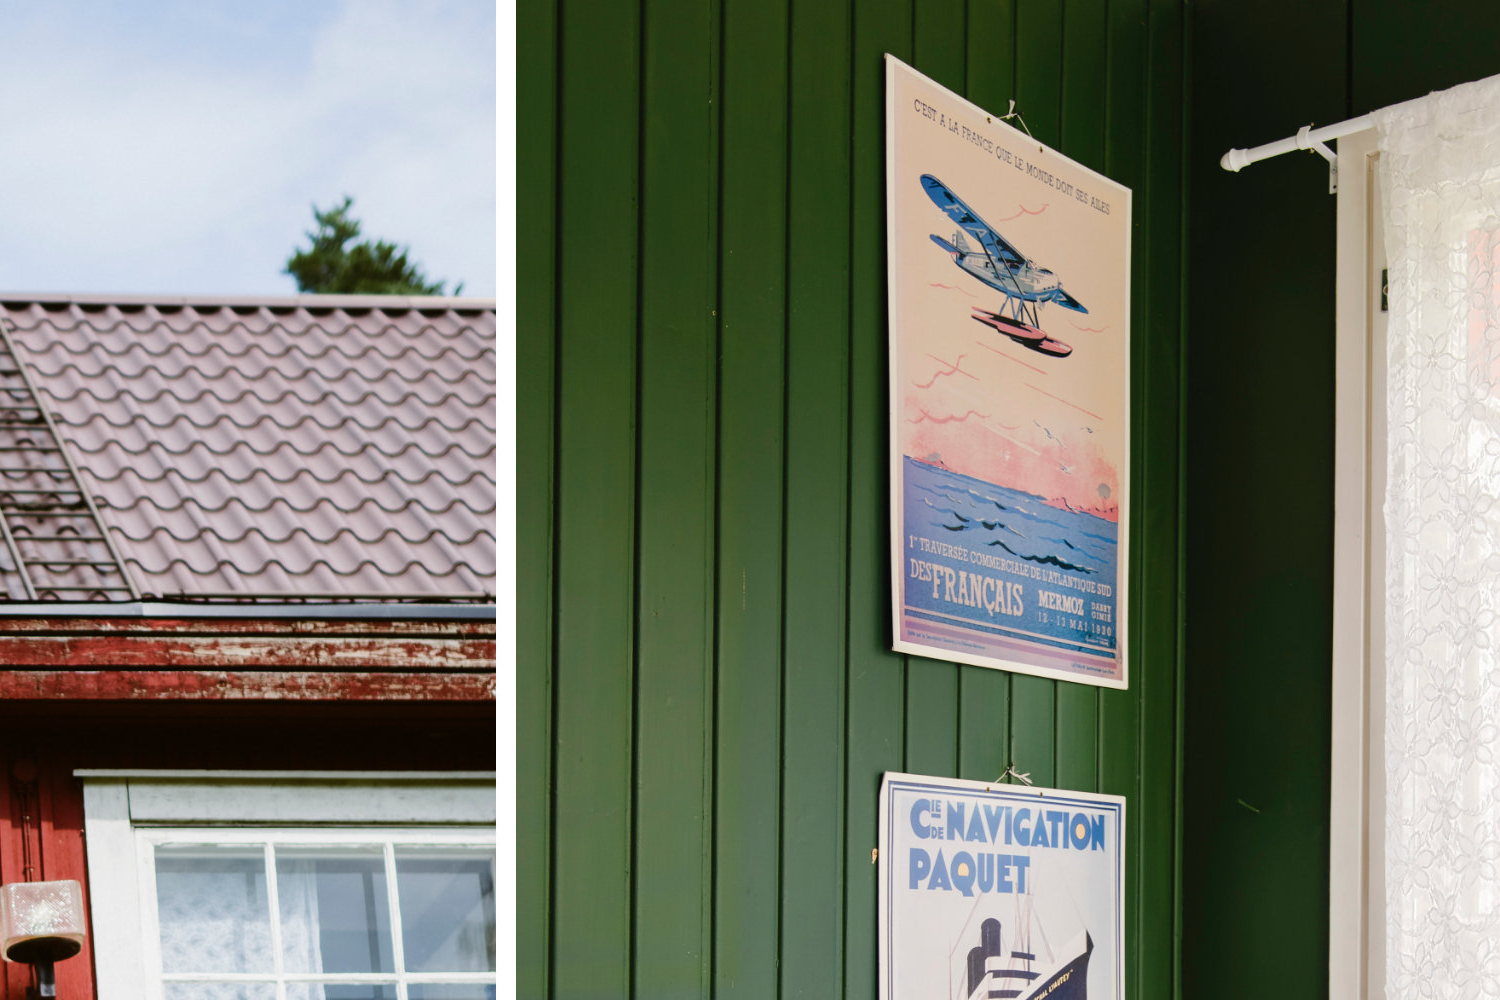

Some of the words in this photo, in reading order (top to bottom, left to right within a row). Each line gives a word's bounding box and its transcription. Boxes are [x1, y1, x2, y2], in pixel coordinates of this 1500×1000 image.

[914, 99, 937, 121] C'EST
[949, 118, 959, 135] LA
[962, 126, 993, 154] FRANCE
[996, 146, 1012, 164] QUE
[1015, 156, 1023, 171] LE
[1026, 162, 1054, 188] MONDE
[1056, 178, 1073, 197] DOIT
[1076, 189, 1088, 205] SES
[1091, 197, 1110, 215] AILES
[910, 558, 932, 582] DES
[932, 563, 1024, 617] FRANÇAIS
[1038, 589, 1084, 616] MERMOZ
[919, 537, 968, 562] TRAVERSÉE
[970, 551, 1029, 577] COMMERCIALE
[1030, 567, 1041, 580] DE
[1042, 569, 1096, 594] L'ATLANTIQUE
[1097, 583, 1112, 598] SUD
[1069, 619, 1088, 632] MAI
[947, 800, 1105, 852] NAVIGATION
[909, 847, 1031, 897] PAQUET
